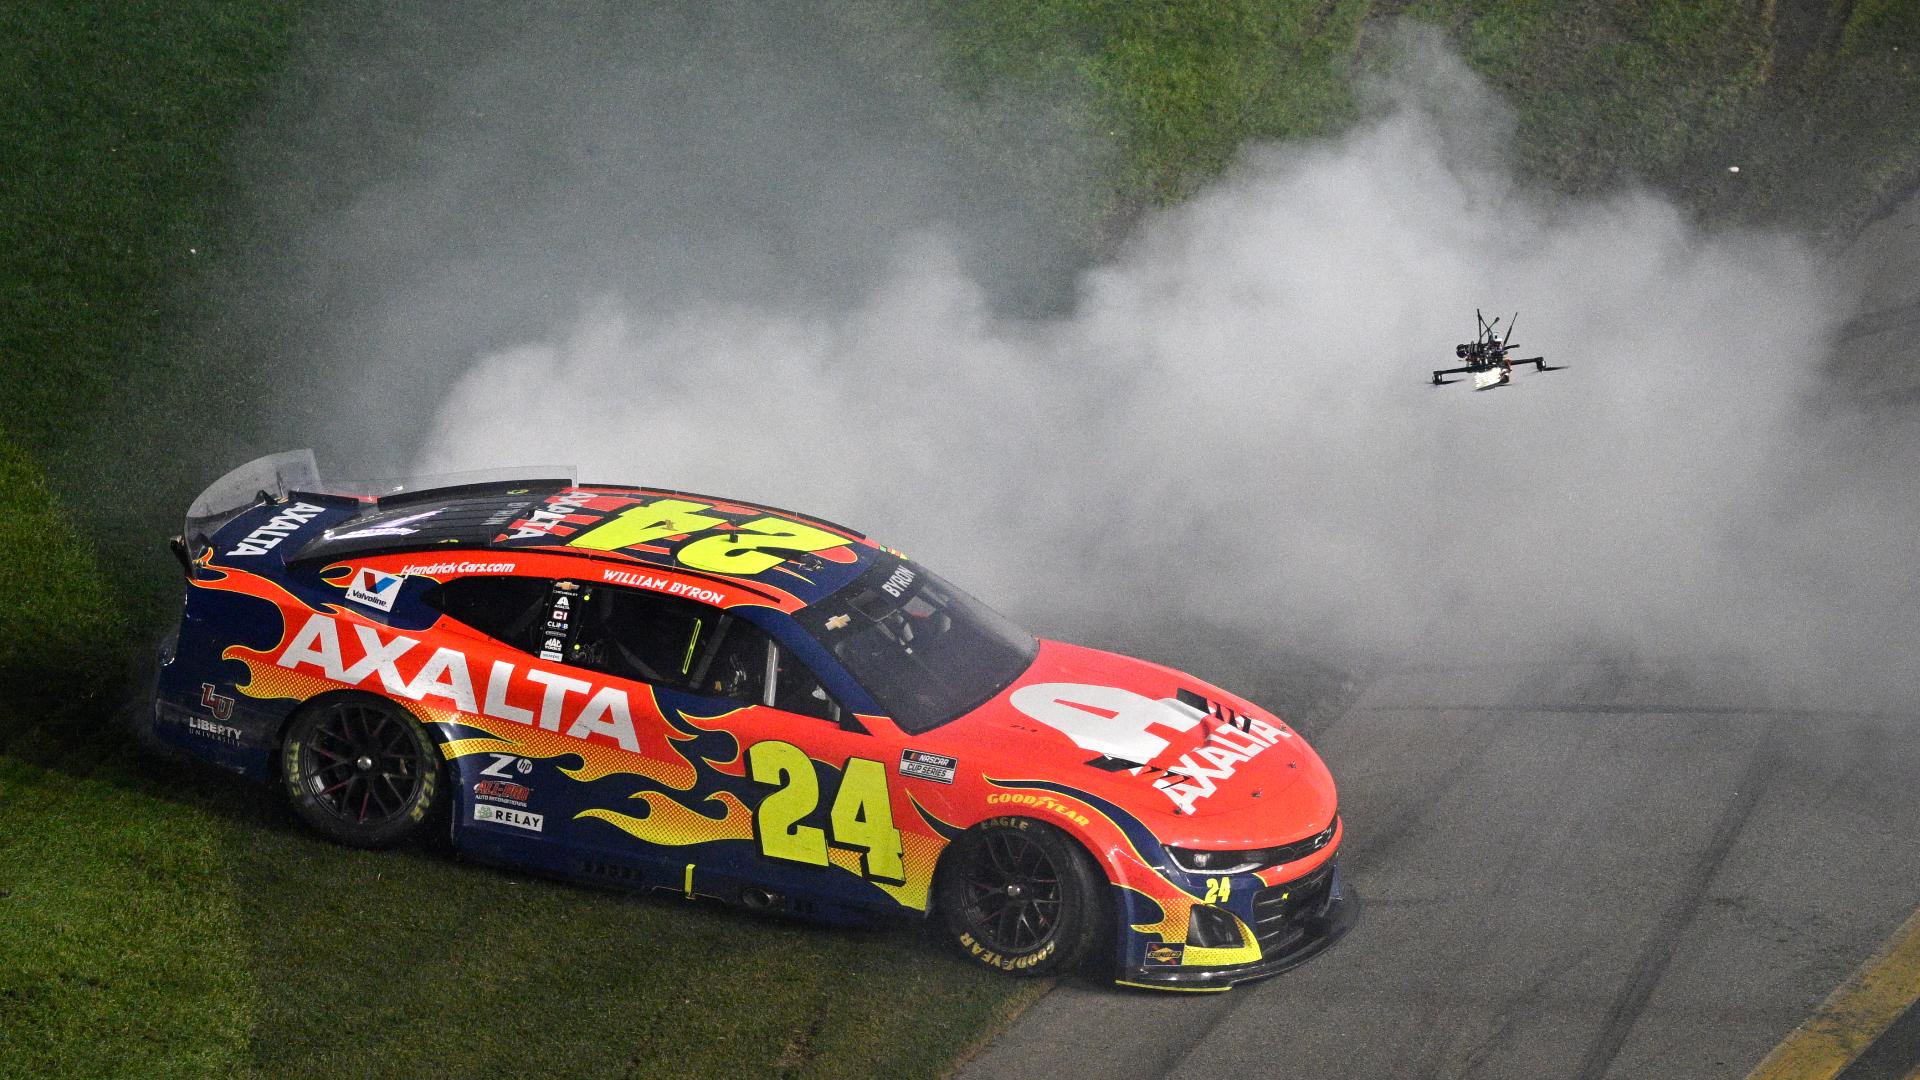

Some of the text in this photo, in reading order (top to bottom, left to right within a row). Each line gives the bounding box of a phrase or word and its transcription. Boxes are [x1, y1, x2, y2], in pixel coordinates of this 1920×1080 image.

[225, 501, 326, 556] AXALTA
[508, 491, 599, 540] AXALTA
[352, 589, 388, 606] Valvoline
[603, 569, 724, 605] WILLIAM BYRON
[881, 564, 916, 598] BYRON
[277, 613, 642, 755] AXALTA
[189, 716, 242, 740] LIBERTY
[480, 753, 518, 779] Z
[907, 763, 947, 777] CUP SERIES
[919, 753, 950, 766] NASCAR
[1152, 714, 1292, 815] AXALTA
[495, 810, 540, 828] RELAY
[747, 740, 907, 882] 24
[981, 817, 1030, 832] EAGLE
[987, 793, 1090, 827] GOODYEAR
[1204, 876, 1231, 904] 24
[960, 932, 1055, 971] GOODYEAR
